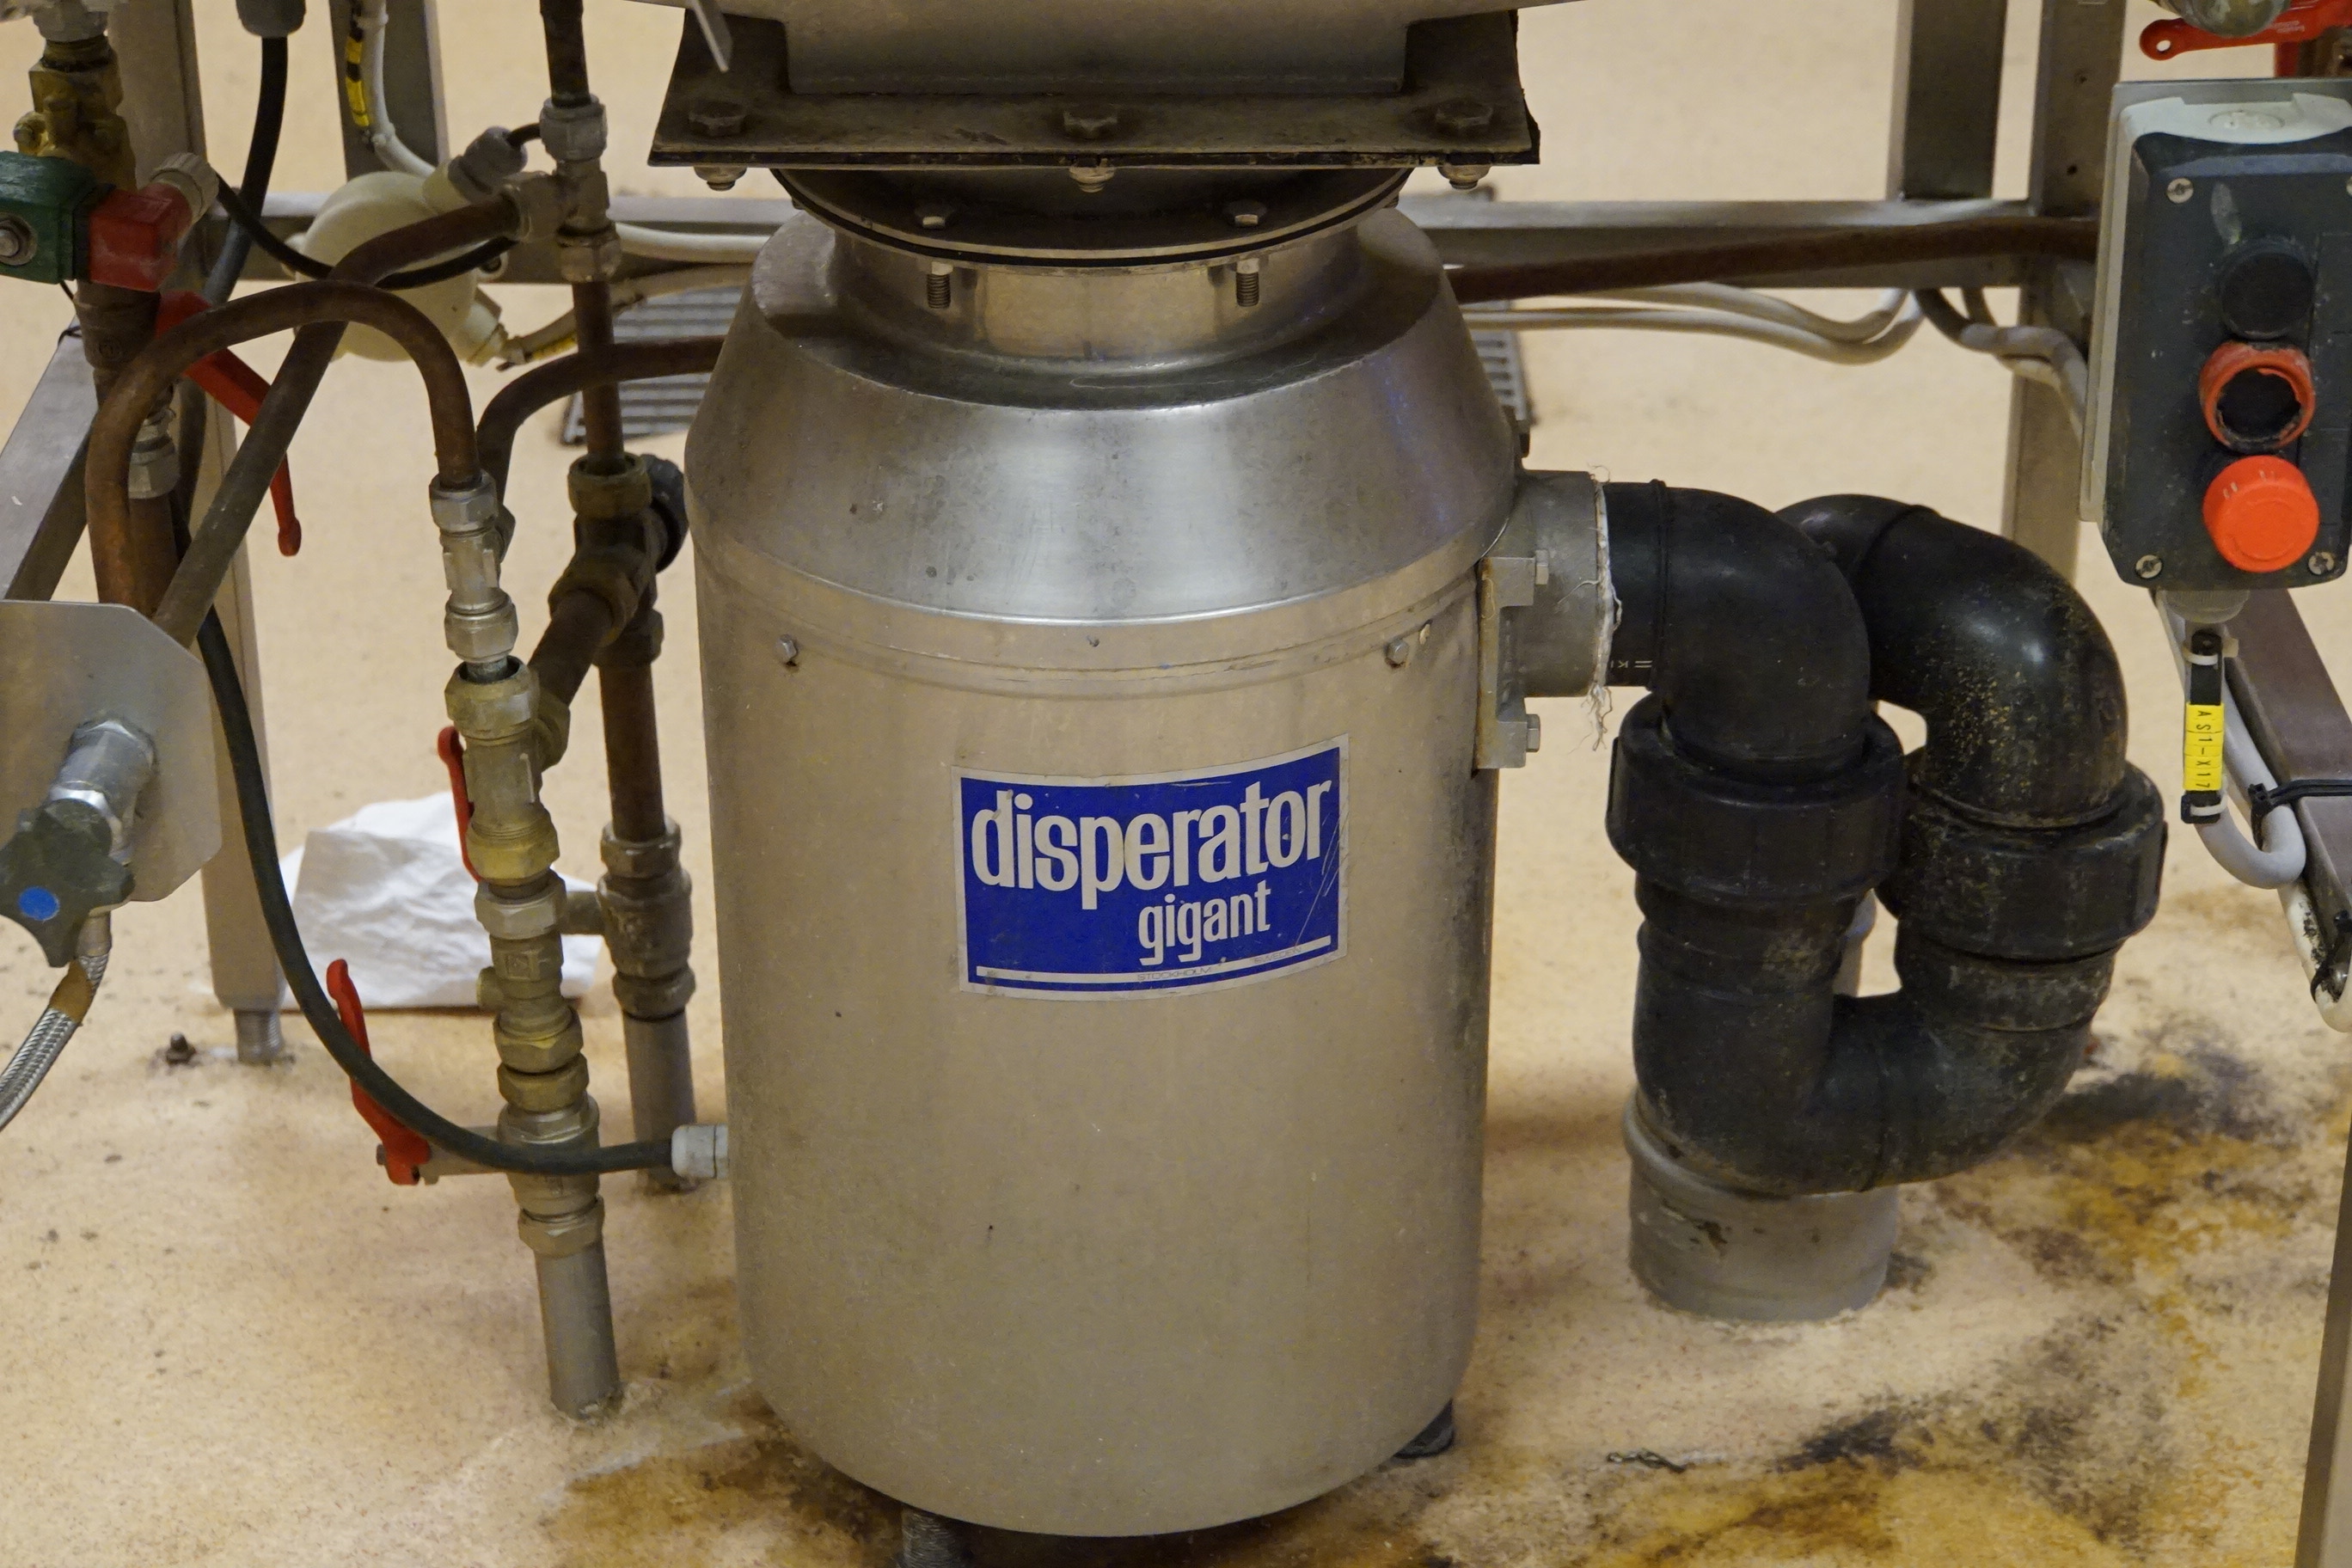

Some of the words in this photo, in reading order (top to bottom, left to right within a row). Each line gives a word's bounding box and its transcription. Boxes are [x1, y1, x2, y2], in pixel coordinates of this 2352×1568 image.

[971, 780, 1332, 910] disperator
[1136, 966, 1212, 982] STOCKHOLM
[1253, 946, 1302, 965] SWEDEN
[1138, 879, 1271, 966] gigant
